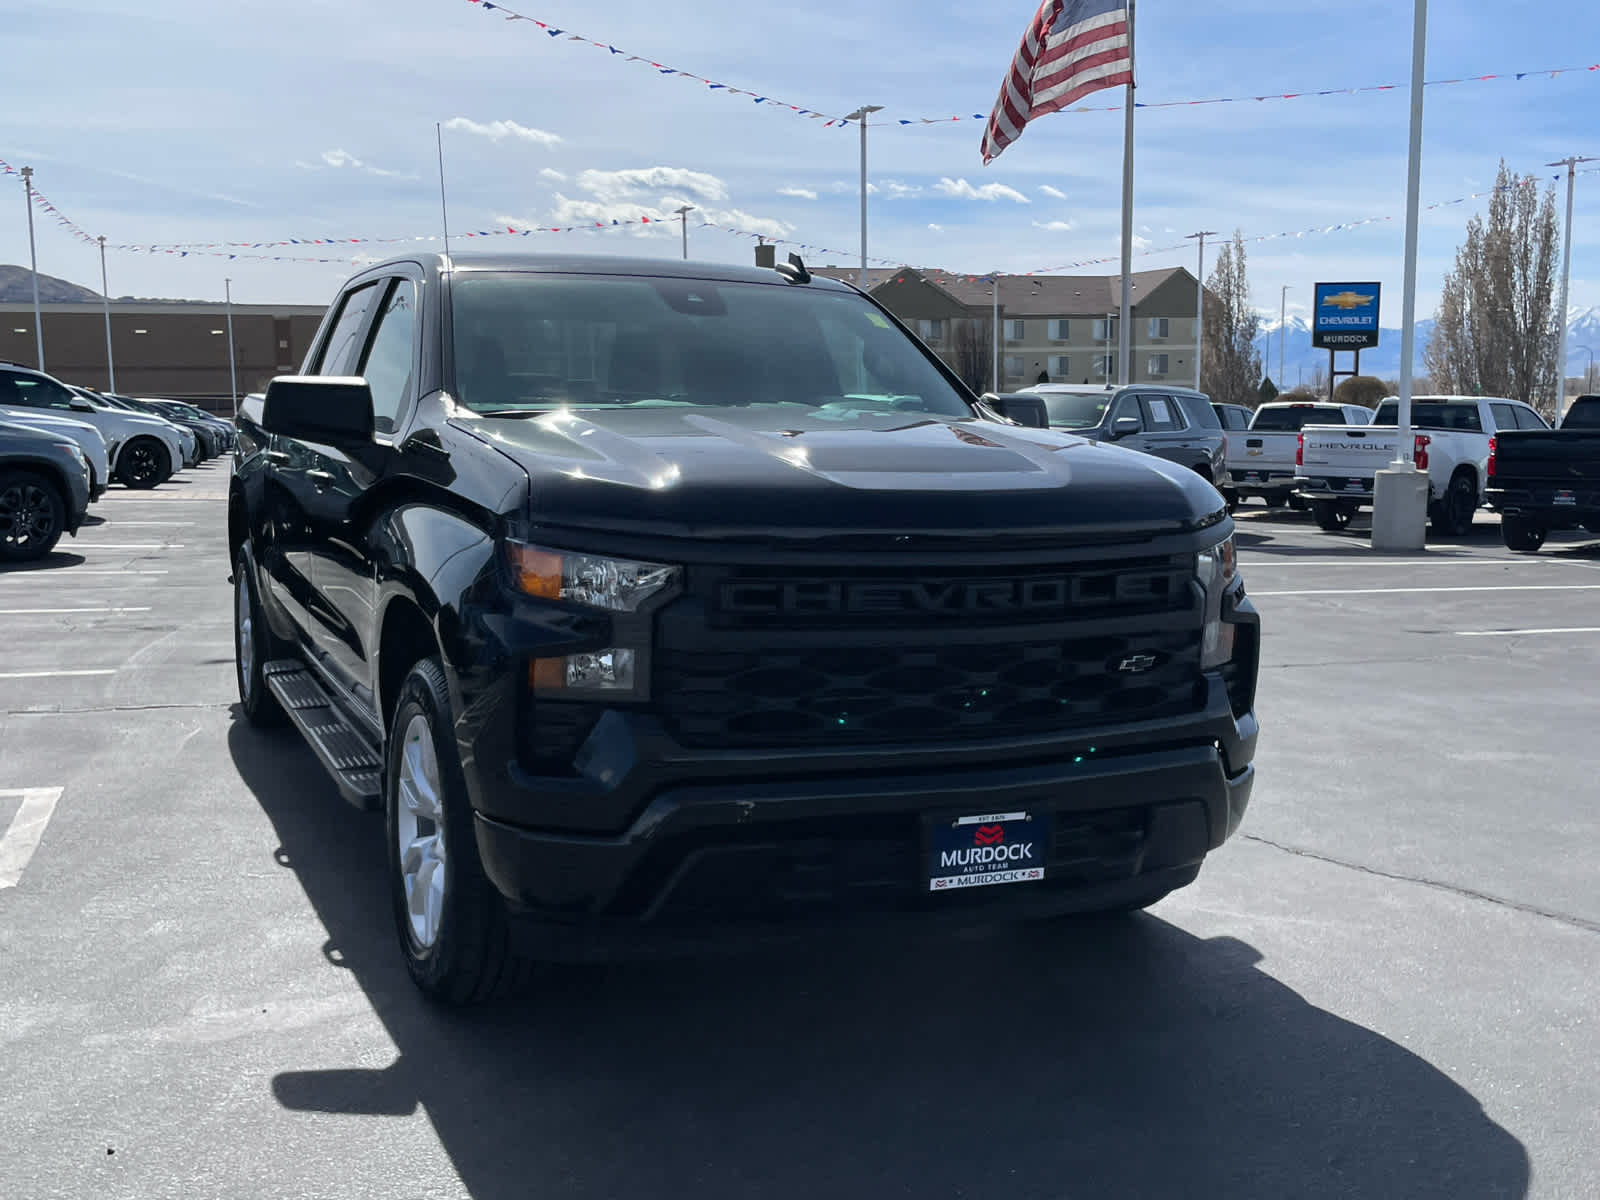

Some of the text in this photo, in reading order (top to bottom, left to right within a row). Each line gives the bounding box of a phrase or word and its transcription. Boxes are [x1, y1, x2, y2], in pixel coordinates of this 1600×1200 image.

[1319, 316, 1373, 325] CHEVROLET
[1323, 335, 1368, 343] MURDOCK
[940, 842, 1033, 868] MURDOCK
[963, 861, 1009, 873] AUTO TEAM
[957, 871, 1019, 886] MURDOCK
